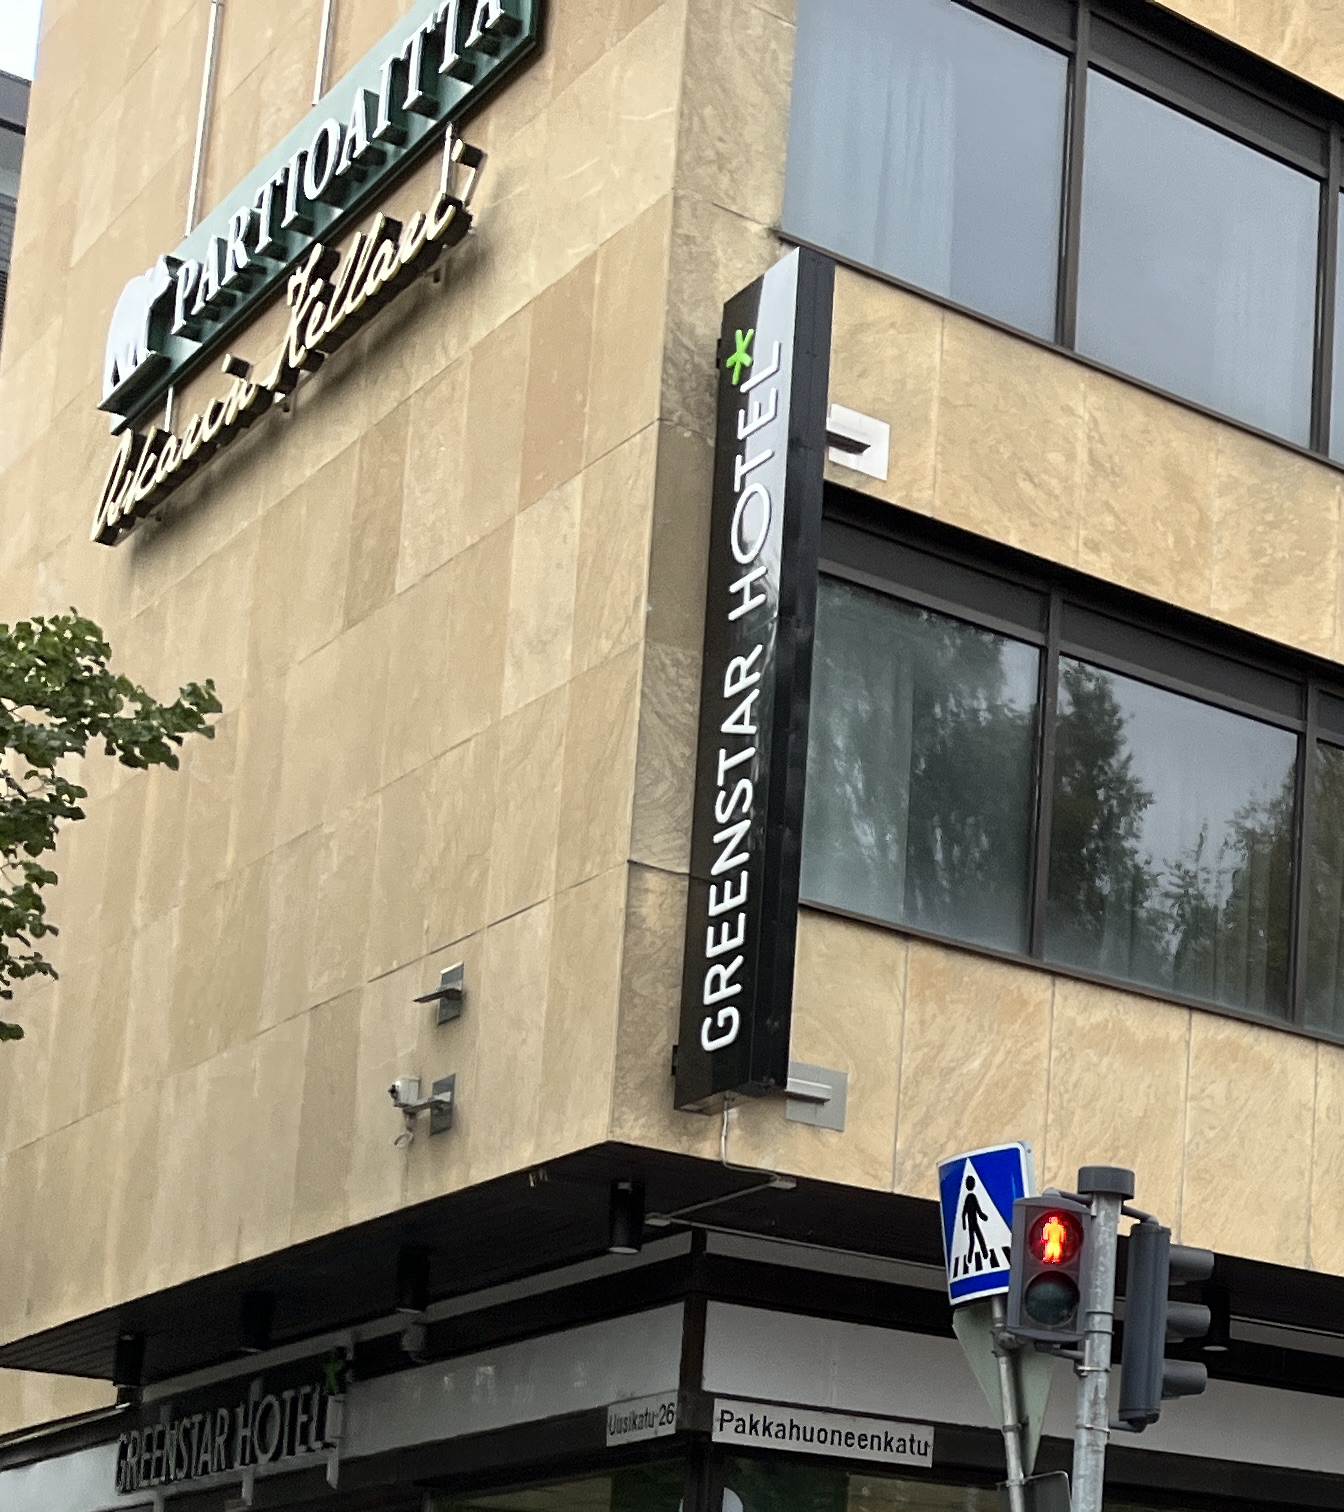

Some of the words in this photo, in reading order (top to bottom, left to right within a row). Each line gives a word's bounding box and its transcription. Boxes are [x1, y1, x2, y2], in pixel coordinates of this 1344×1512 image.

[171, 0, 507, 336] PARTIOAITTA
[262, 138, 467, 391] Kellari
[728, 340, 781, 621] HOTEL
[701, 644, 763, 1052] GREENSTAR
[116, 1406, 230, 1495] GREENSTAR
[235, 1383, 334, 1465] HOTEL
[607, 1409, 655, 1436] Uusikatu
[658, 1402, 676, 1427] 26
[719, 1408, 931, 1458] Pakkahuoneenkatu
